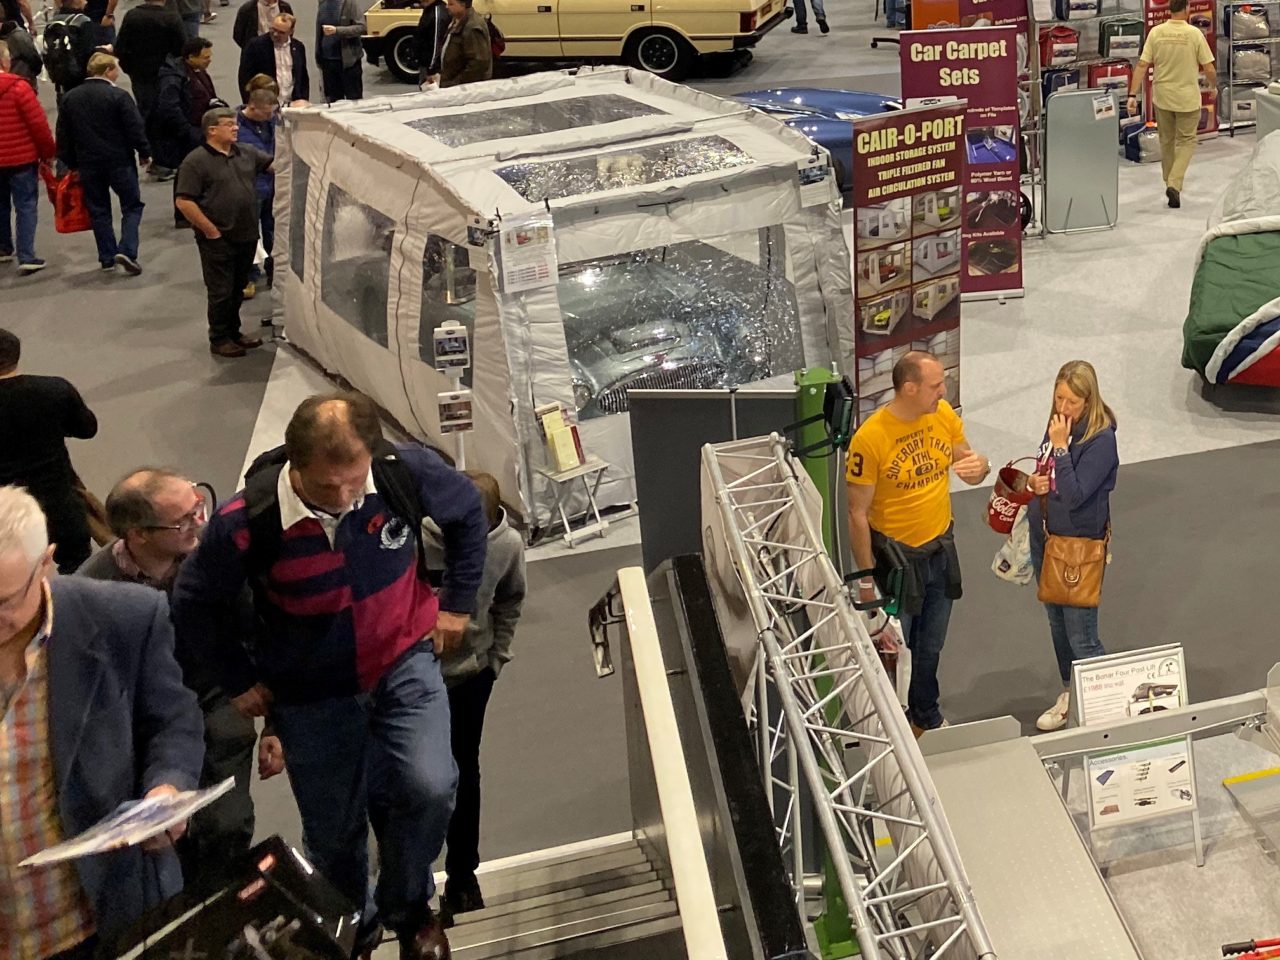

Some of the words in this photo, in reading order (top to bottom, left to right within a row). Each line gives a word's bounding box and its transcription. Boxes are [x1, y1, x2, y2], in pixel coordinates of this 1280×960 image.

[911, 43, 943, 62] Car
[946, 40, 1007, 61] Carpet
[939, 67, 980, 87] Sets
[857, 115, 964, 155] CAIR-O-PORT
[867, 152, 895, 167] INDOOR
[895, 147, 927, 163] STORAGE
[927, 141, 956, 156] SYSTEM
[877, 167, 901, 181] TRIPLE
[901, 161, 931, 176] FILTERED
[932, 158, 946, 170] FAN
[868, 187, 880, 199] AIR
[881, 177, 927, 196] CIRCULATION
[927, 171, 955, 186] SYSTEM
[895, 429, 924, 445] PROPERTY
[886, 437, 924, 481] SUPERDRY
[929, 436, 952, 458] TRACK
[906, 469, 912, 481] T
[935, 458, 940, 470] F
[912, 450, 933, 467] ATHL
[992, 496, 1019, 516] Cola
[1082, 674, 1094, 683] The
[1096, 671, 1114, 681] Bonar
[1115, 668, 1130, 678] Four
[1131, 666, 1144, 676] Post
